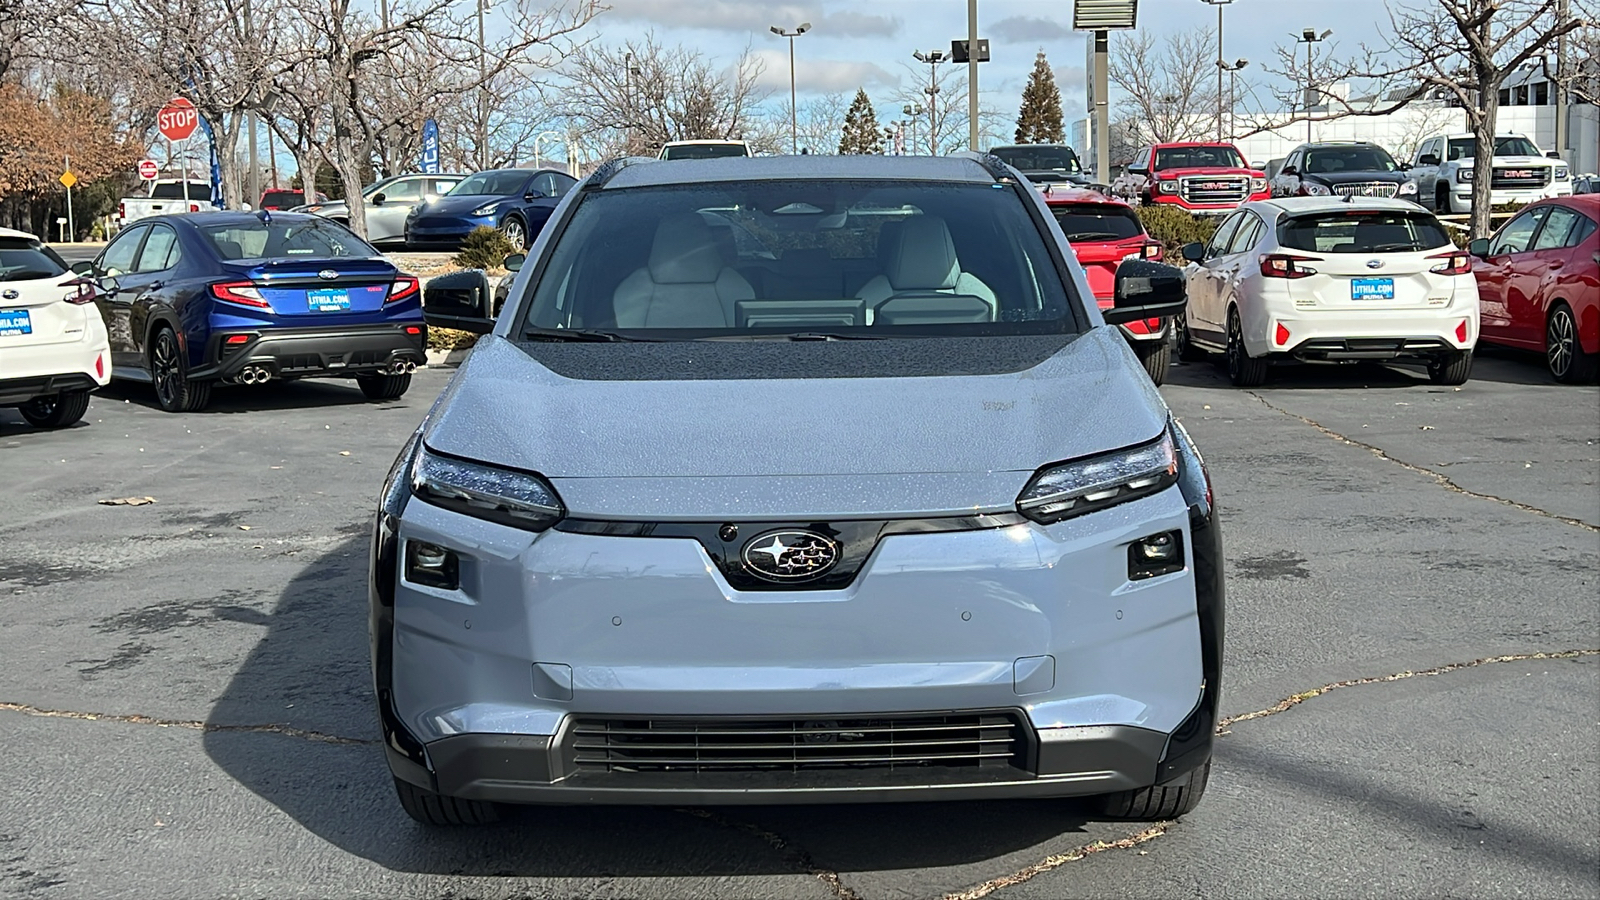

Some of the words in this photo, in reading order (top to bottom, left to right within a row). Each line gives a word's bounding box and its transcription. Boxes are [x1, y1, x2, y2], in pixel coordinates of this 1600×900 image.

[161, 109, 195, 130] STOP
[1504, 170, 1532, 178] GMC
[1202, 182, 1230, 190] GMC
[1353, 284, 1393, 294] LITHIA.COM
[308, 294, 349, 305] LITHIA.COM
